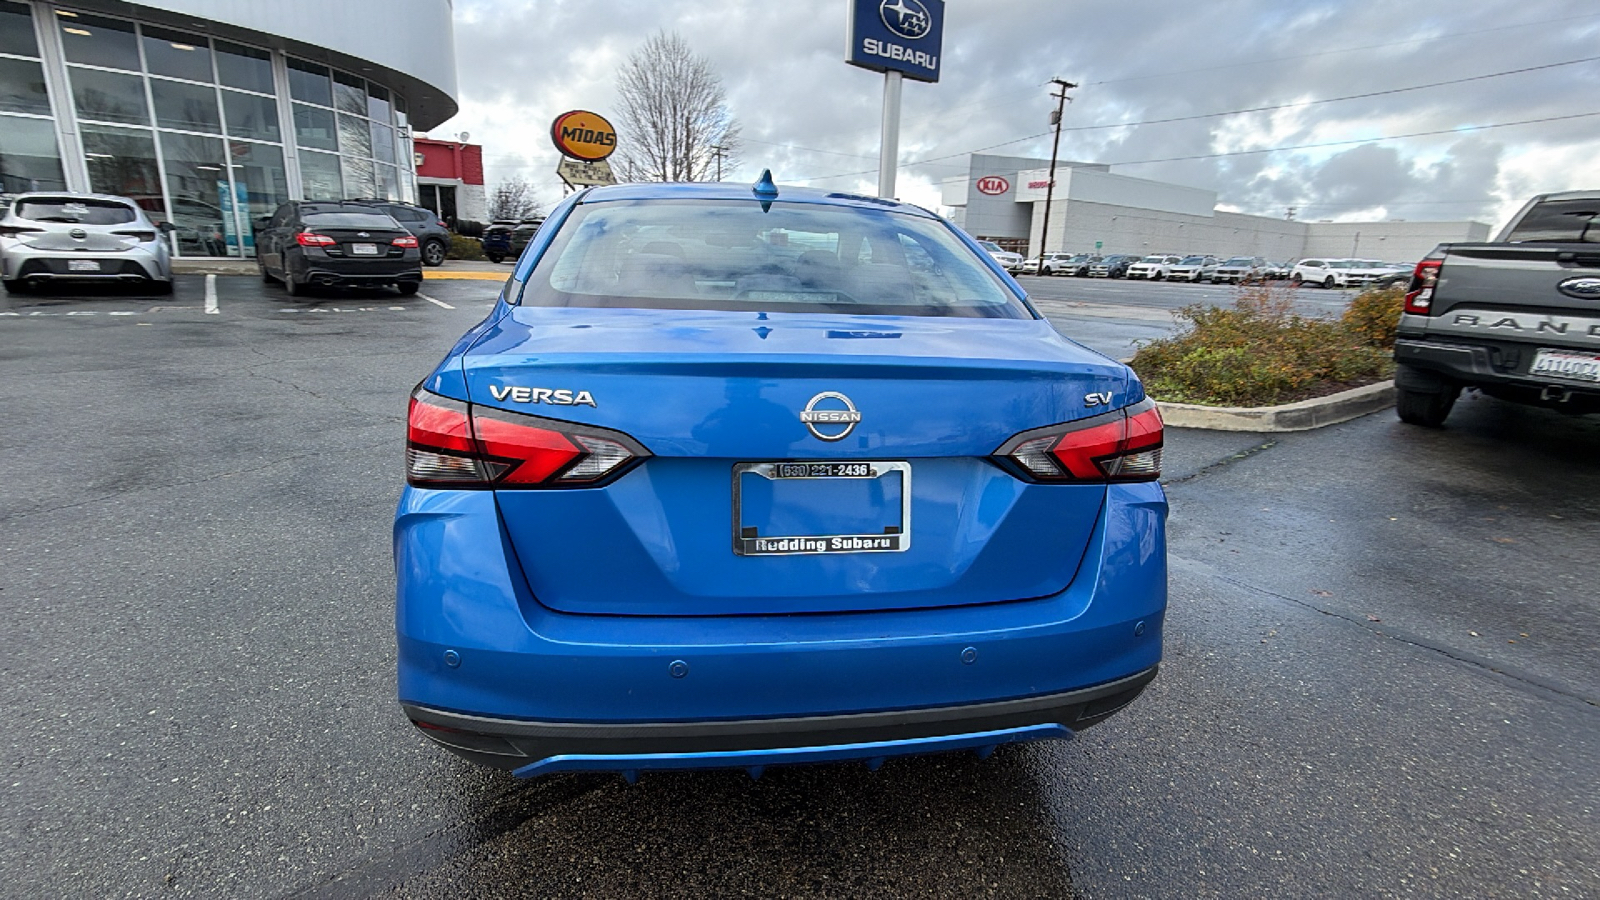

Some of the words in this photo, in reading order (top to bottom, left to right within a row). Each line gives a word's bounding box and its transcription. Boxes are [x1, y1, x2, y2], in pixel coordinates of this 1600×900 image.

[863, 37, 937, 70] SUBARU
[561, 123, 616, 146] MIDAS
[982, 179, 1004, 192] KIA
[489, 384, 597, 408] VERSA
[1083, 391, 1113, 408] SV
[801, 412, 861, 422] NISSAN
[779, 464, 810, 477] (530)
[811, 464, 868, 476] 221-2436
[755, 538, 827, 552] Redding
[831, 537, 891, 549] Subaru
